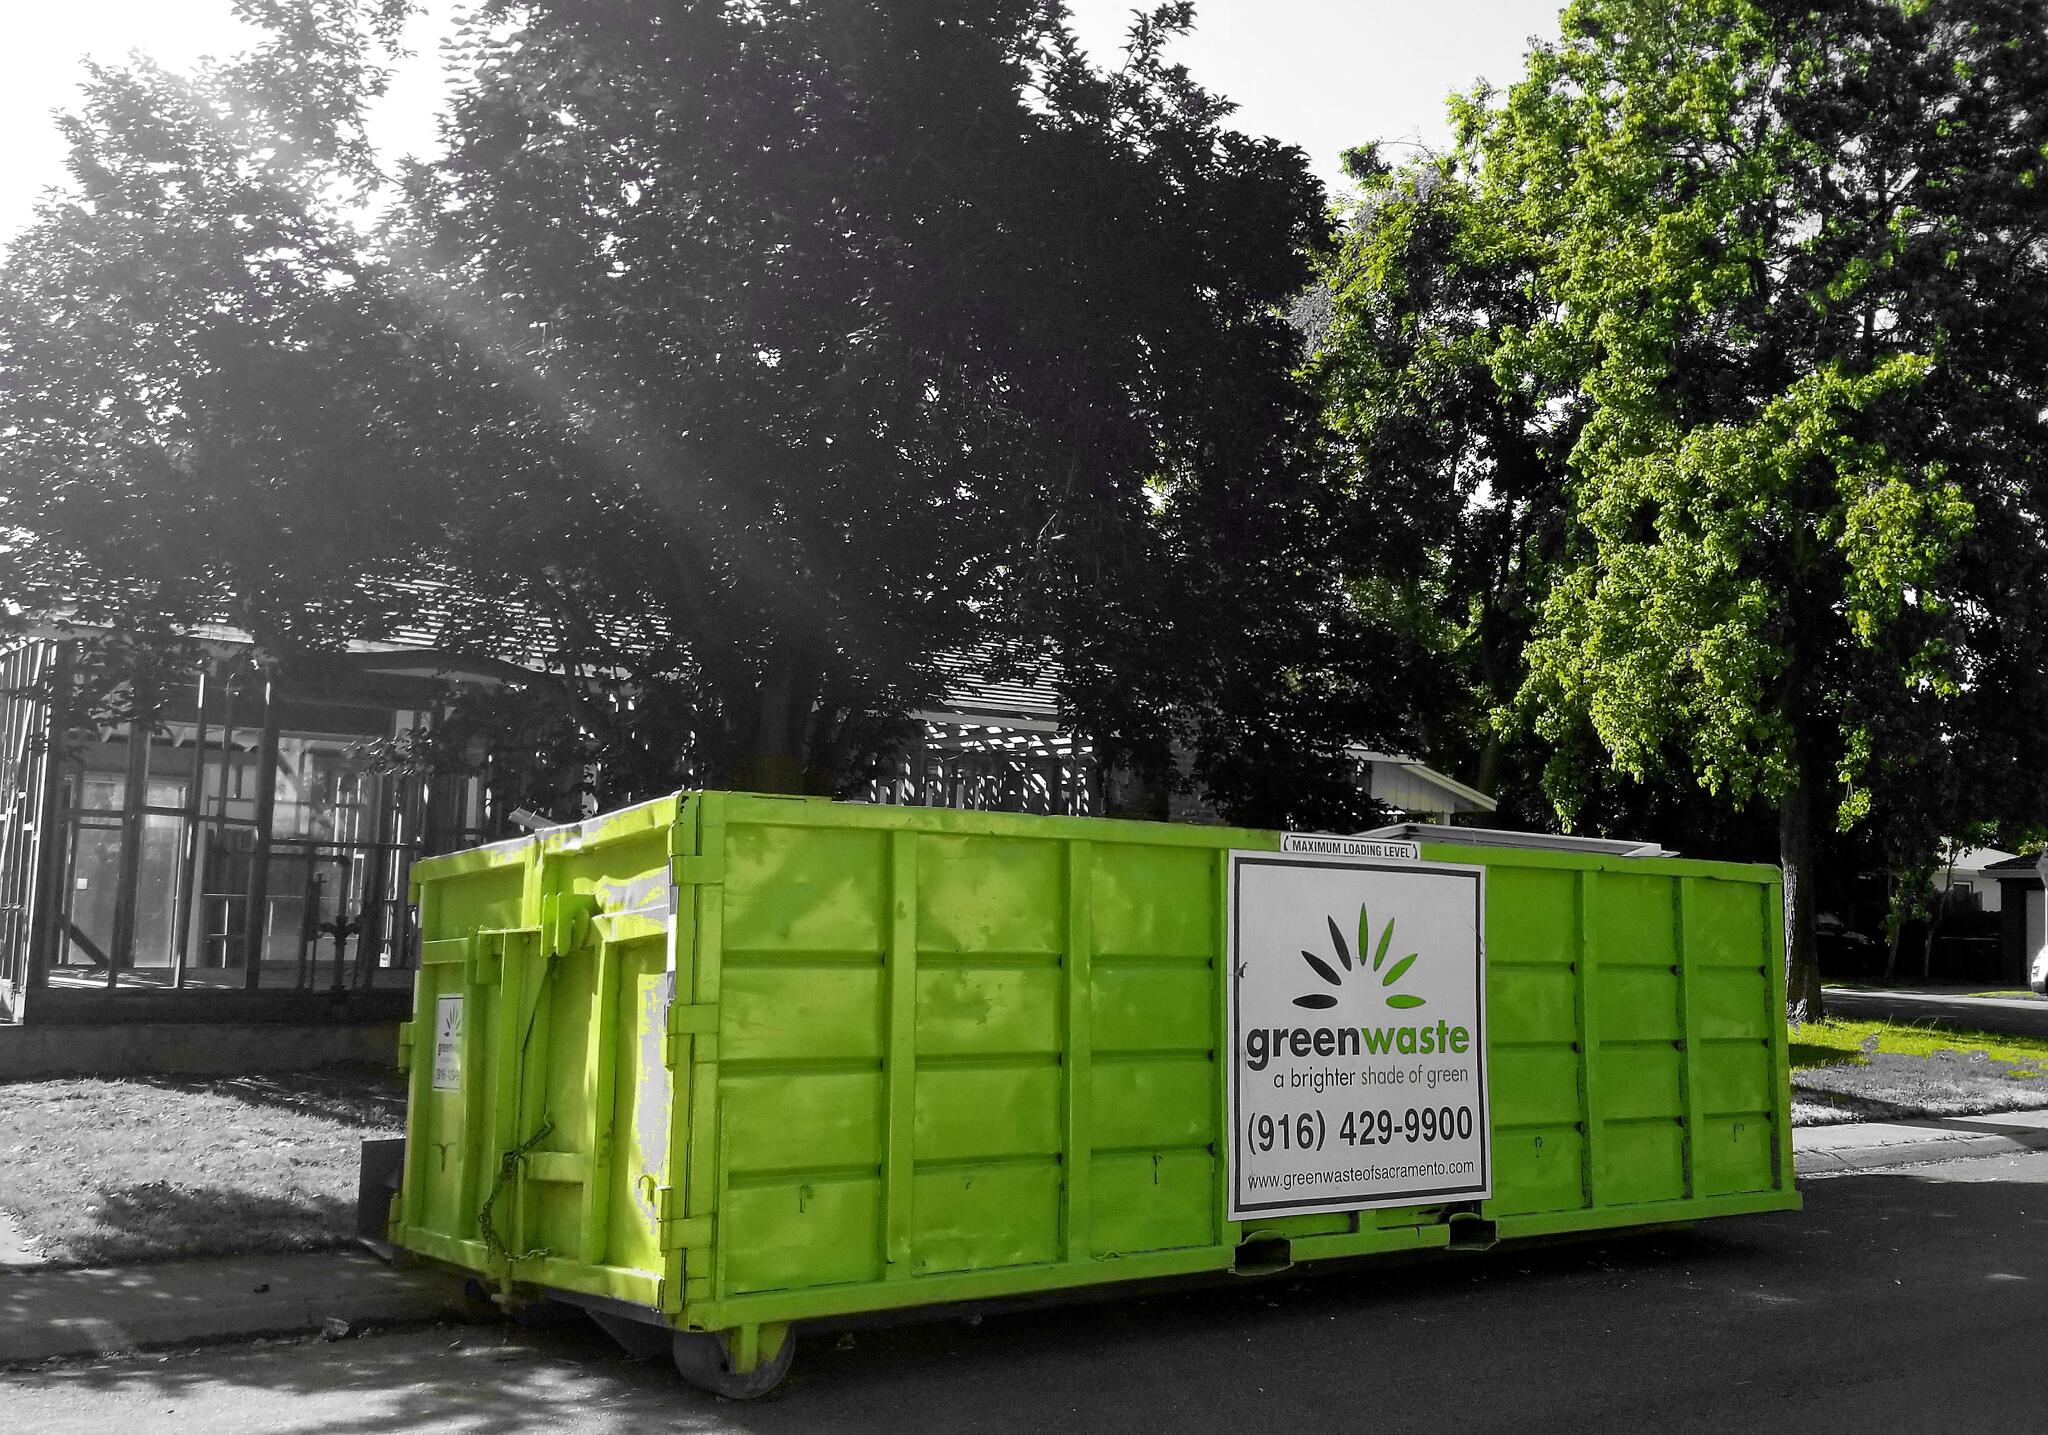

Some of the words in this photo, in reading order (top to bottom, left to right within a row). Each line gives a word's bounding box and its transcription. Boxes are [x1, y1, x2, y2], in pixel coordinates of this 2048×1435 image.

[1292, 840, 1341, 854] MAXIMUM
[1344, 843, 1382, 857] LOADING
[1384, 846, 1410, 858] LEVEL
[1246, 1020, 1469, 1071] greenwaste
[1274, 1074, 1284, 1087] a
[1291, 1067, 1355, 1093] brighter
[1361, 1066, 1404, 1085] shade
[1409, 1065, 1423, 1083] of
[1427, 1067, 1468, 1089] green
[1248, 1110, 1325, 1155] (916)
[1339, 1106, 1472, 1145] 429-9900
[1248, 1160, 1474, 1190] www.greenwasteofsacramento.com
